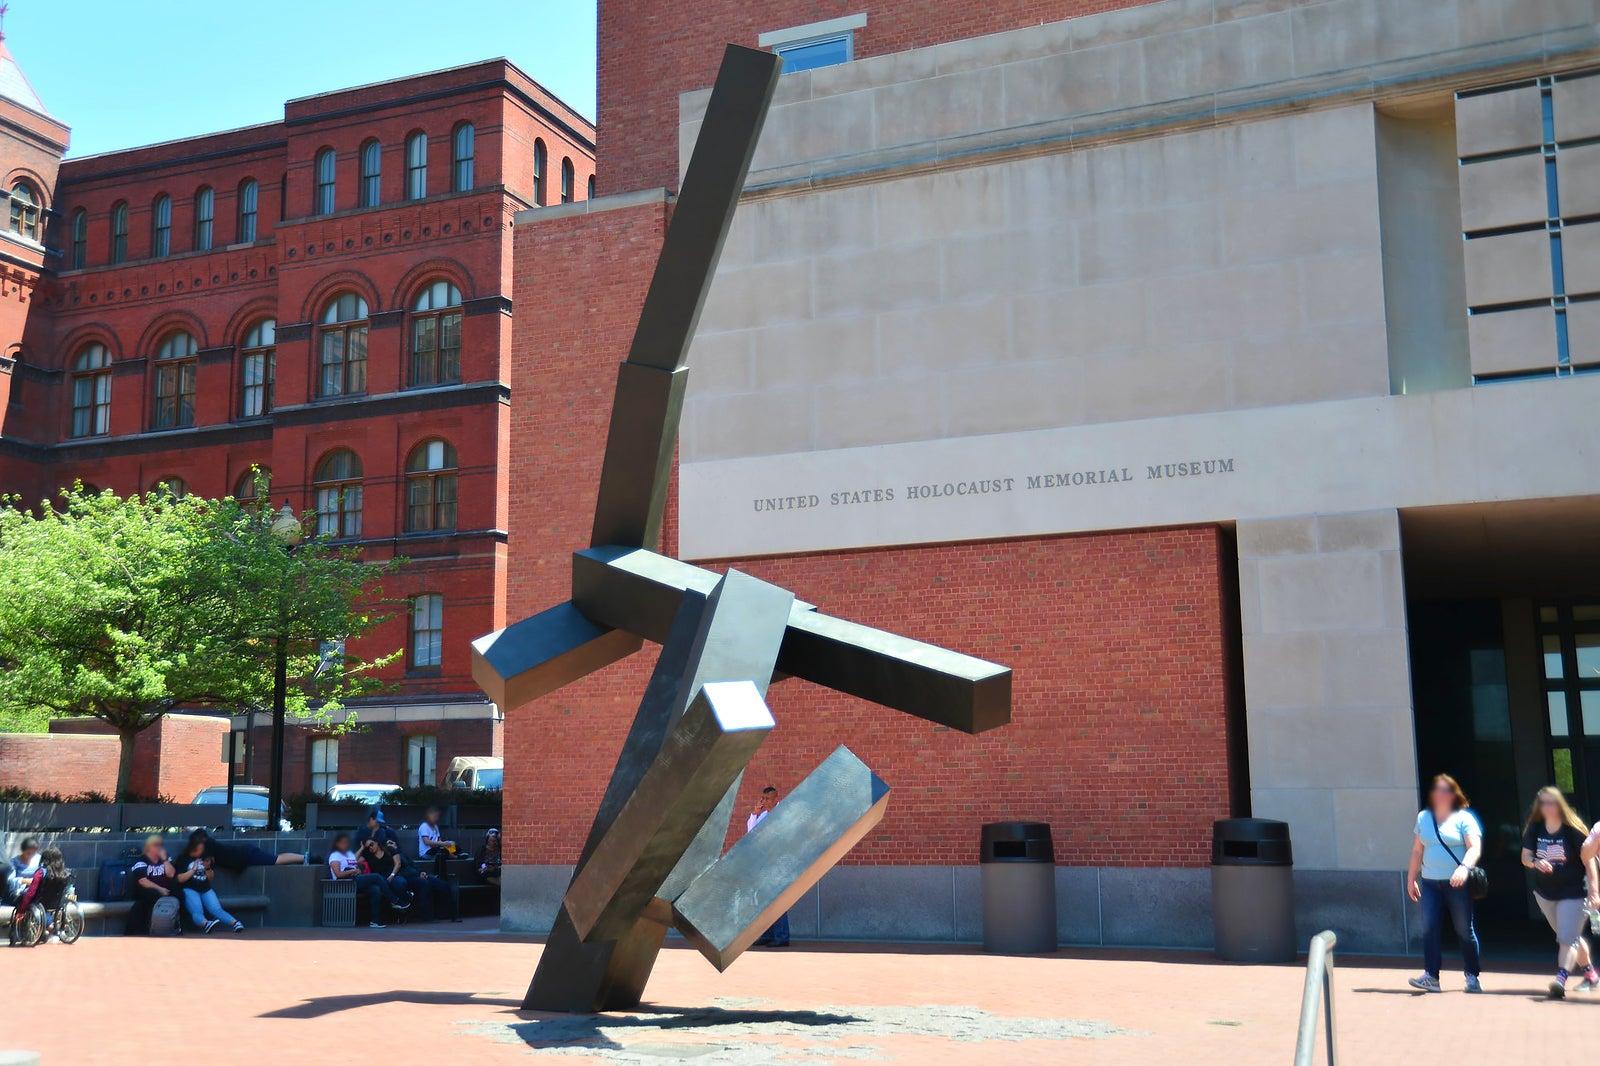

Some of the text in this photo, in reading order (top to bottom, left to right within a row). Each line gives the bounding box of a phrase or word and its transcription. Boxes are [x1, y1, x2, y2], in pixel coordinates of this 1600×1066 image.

[753, 458, 1235, 512] UNITED STATES HOLOCAUST MEMORIAL MUSEUM
